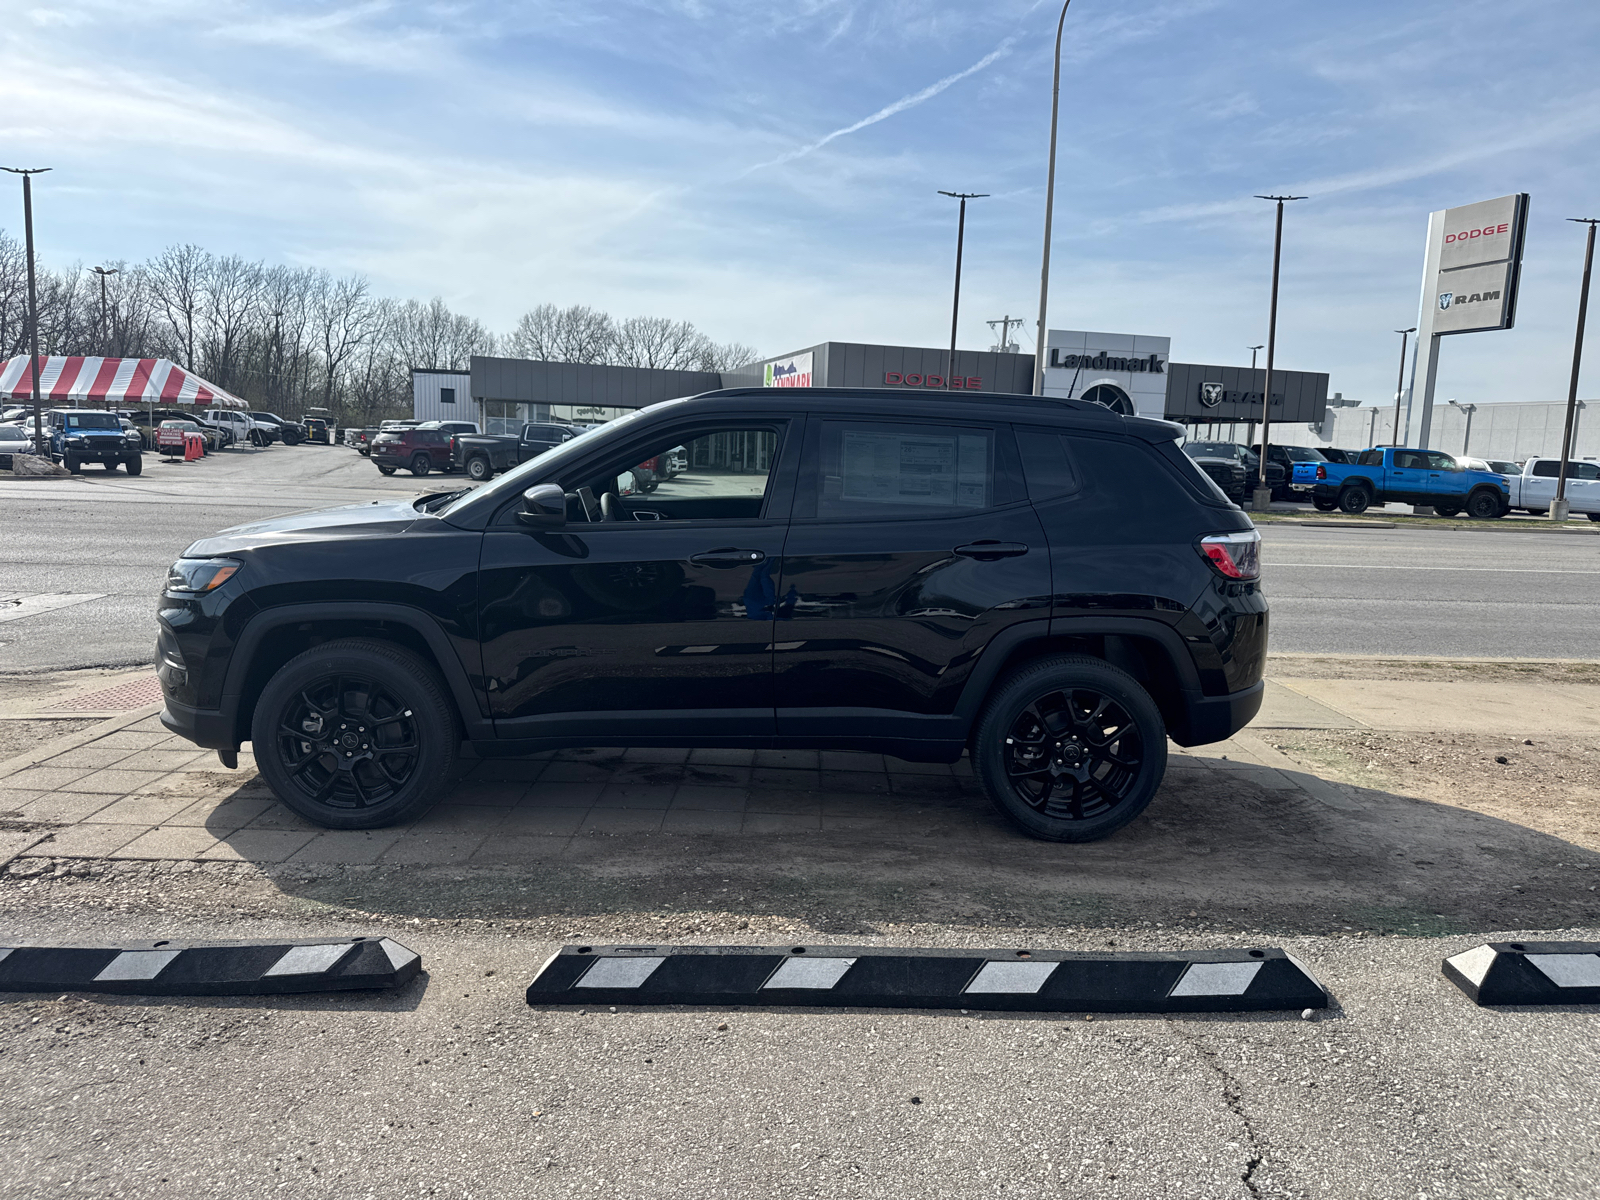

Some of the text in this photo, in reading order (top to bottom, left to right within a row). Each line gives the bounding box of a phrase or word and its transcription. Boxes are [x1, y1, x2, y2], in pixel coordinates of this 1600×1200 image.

[1445, 223, 1509, 243] DODGE
[1454, 290, 1501, 305] RAM
[1050, 348, 1165, 373] Landmark
[884, 372, 983, 390] DODGE
[1223, 390, 1285, 406] RAM
[514, 648, 618, 657] COMPASS
